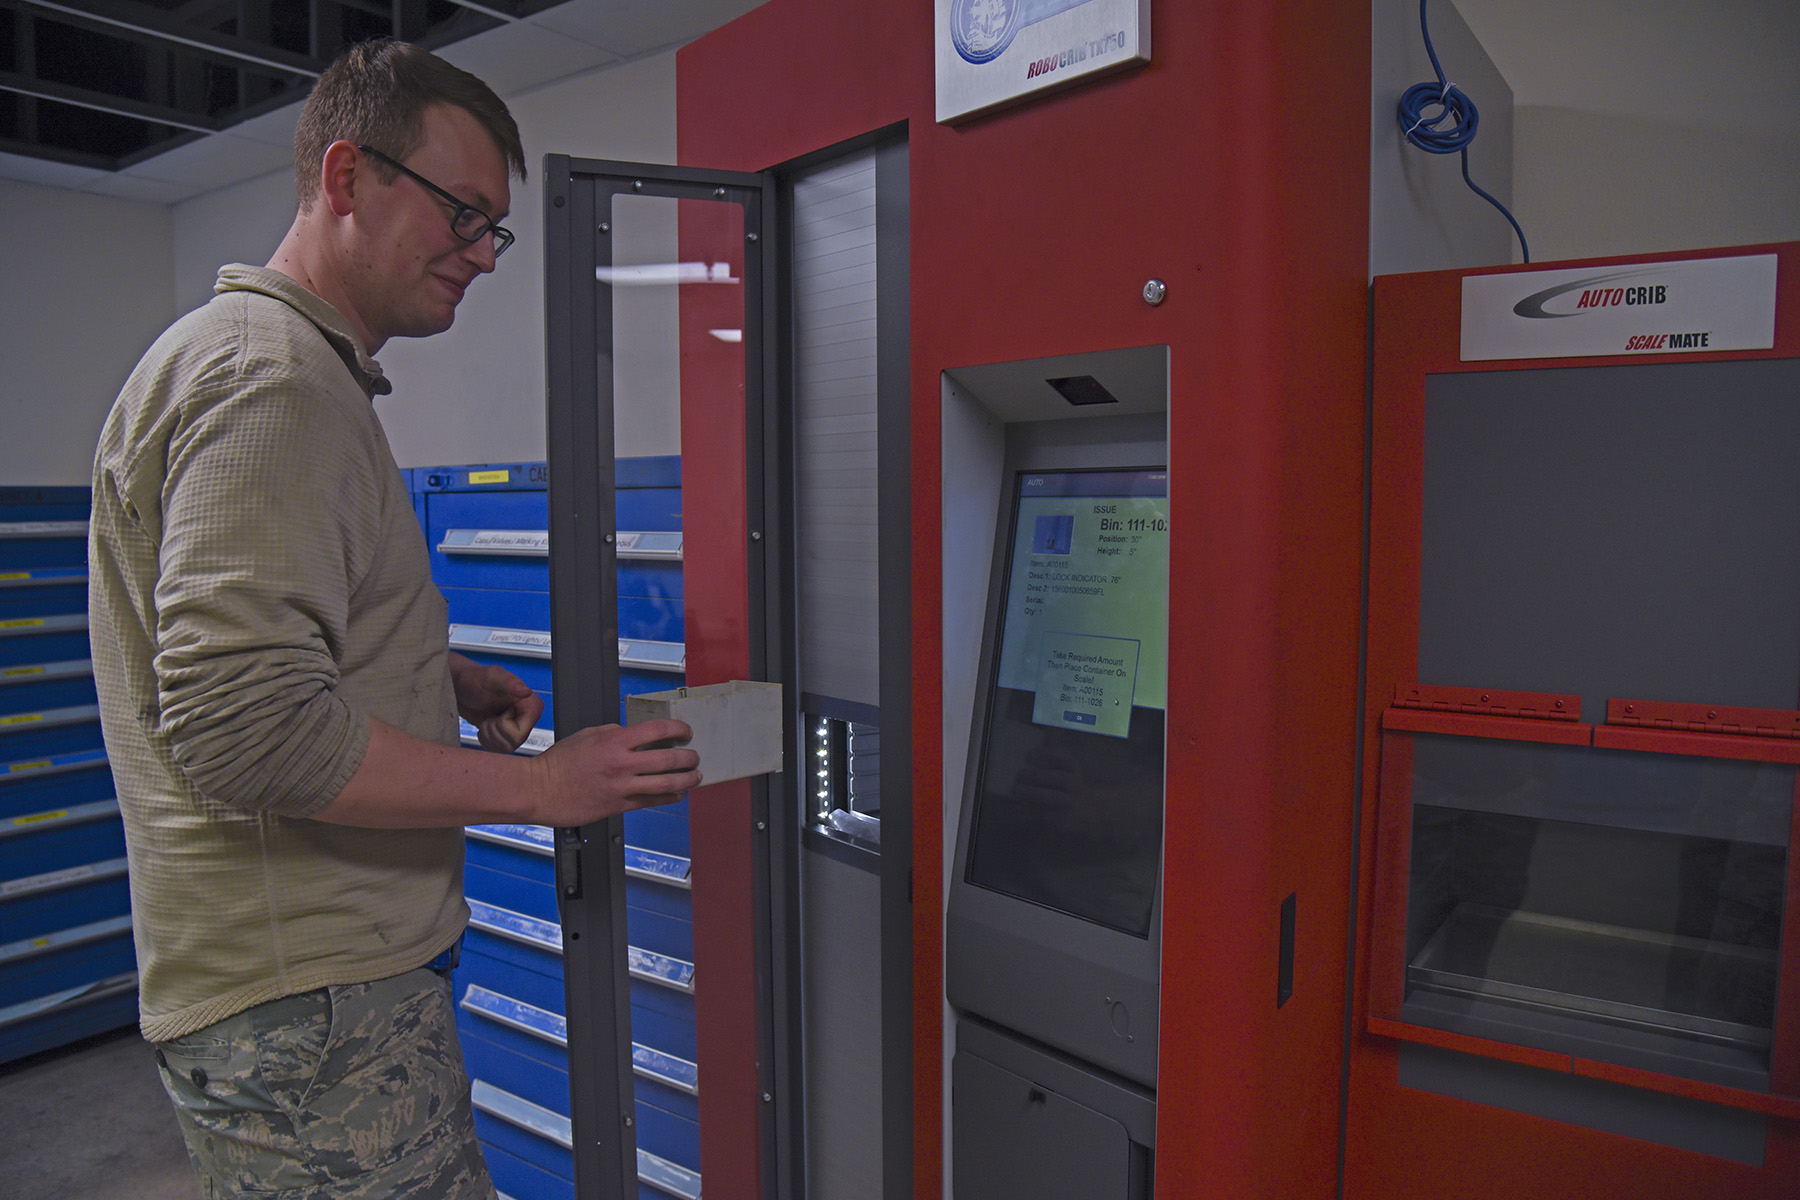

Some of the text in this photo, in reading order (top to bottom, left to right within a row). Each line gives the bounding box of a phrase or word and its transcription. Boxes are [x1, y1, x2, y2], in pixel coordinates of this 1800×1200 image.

[1027, 478, 1044, 487] AUTO
[1093, 505, 1117, 514] ISSUE
[1100, 518, 1123, 531] Bin:
[1098, 535, 1128, 544] Position:
[1097, 547, 1121, 556] Height:
[1071, 574, 1107, 583] INDICATOR
[1052, 650, 1124, 666] Take Required Amount
[1047, 660, 1127, 677] Then Place Container On
[1079, 686, 1104, 697] A00115
[1060, 693, 1073, 703] Bin:
